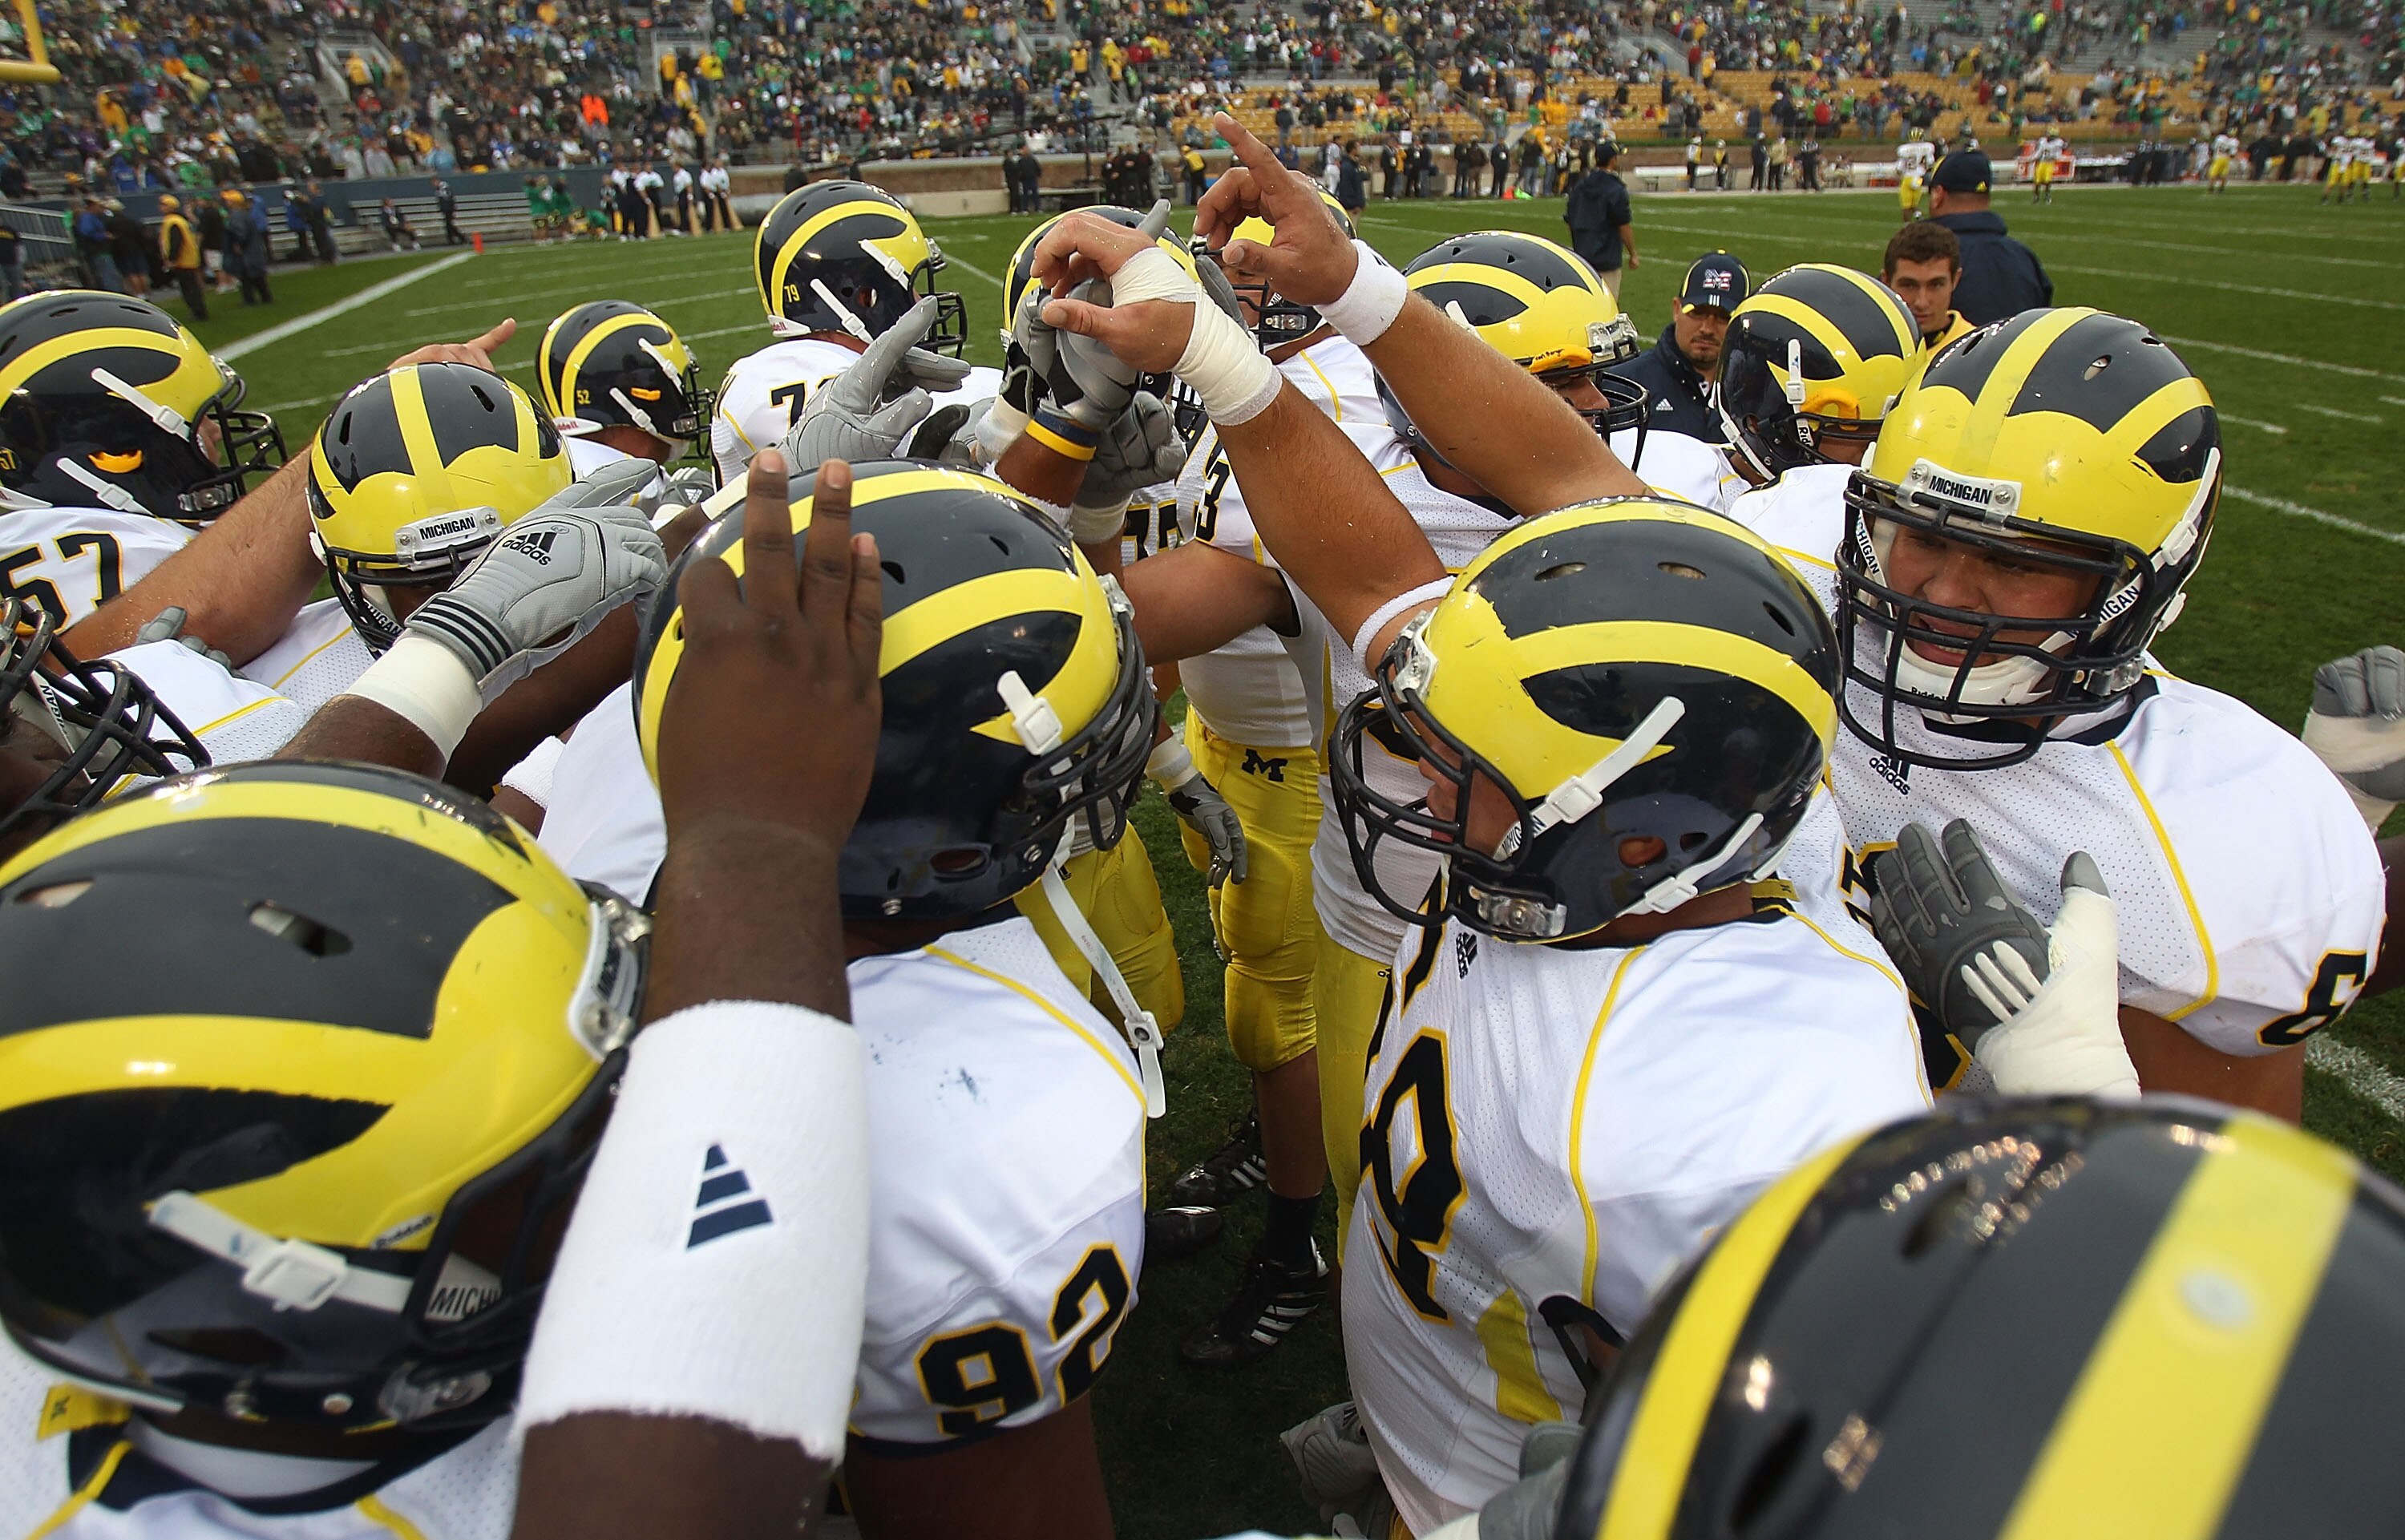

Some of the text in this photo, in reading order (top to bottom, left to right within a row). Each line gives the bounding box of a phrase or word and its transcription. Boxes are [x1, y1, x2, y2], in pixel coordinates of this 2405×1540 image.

[784, 284, 800, 303] 79
[576, 389, 591, 405] 52
[1929, 475, 1992, 505] MICHIGAN
[418, 515, 476, 540] MICHIGAN
[501, 538, 552, 566] adidas
[1242, 748, 1288, 782] M
[1869, 756, 1911, 795] adidas
[429, 1287, 499, 1319] MICH
[913, 1241, 1132, 1437] 92
